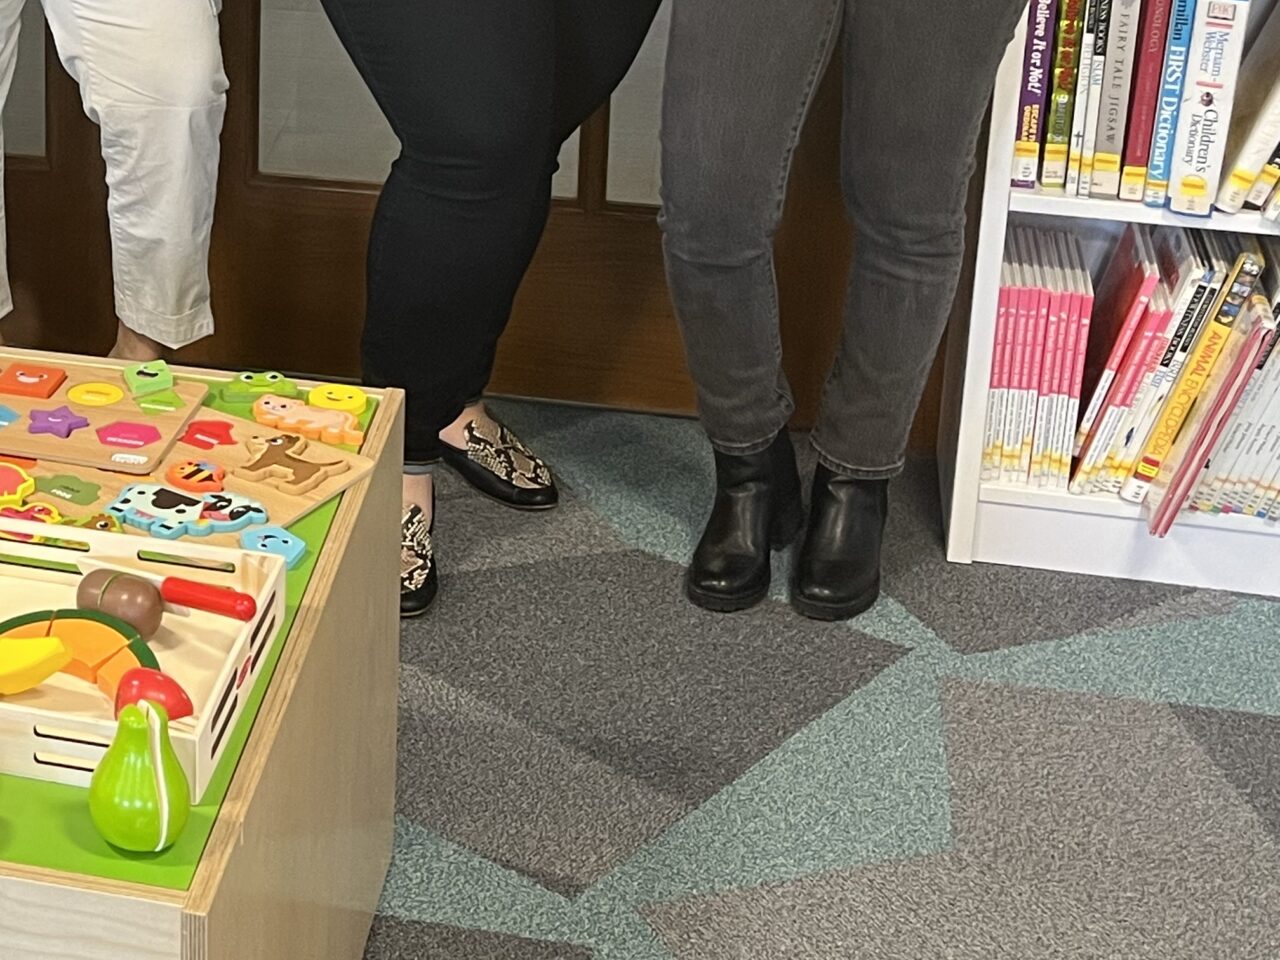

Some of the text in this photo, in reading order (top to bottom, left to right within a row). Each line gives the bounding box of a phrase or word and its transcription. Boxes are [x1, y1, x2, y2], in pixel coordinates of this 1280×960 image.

[1031, 53, 1042, 67] or
[1032, 39, 1047, 54] It
[1095, 20, 1108, 54] BOOKS
[1199, 30, 1215, 73] Webster
[1027, 67, 1044, 95] Not!
[1091, 59, 1102, 86] ISLAM
[1104, 13, 1131, 145] FAIRY TALE JIGSAW
[1166, 44, 1188, 94] FIRST
[1148, 97, 1178, 181] Dictionary
[1182, 113, 1202, 166] Dictionary
[1195, 109, 1219, 173] Children's
[1189, 331, 1223, 383] ANIMAL
[1151, 378, 1201, 457] ENCYCLOPEDIA
